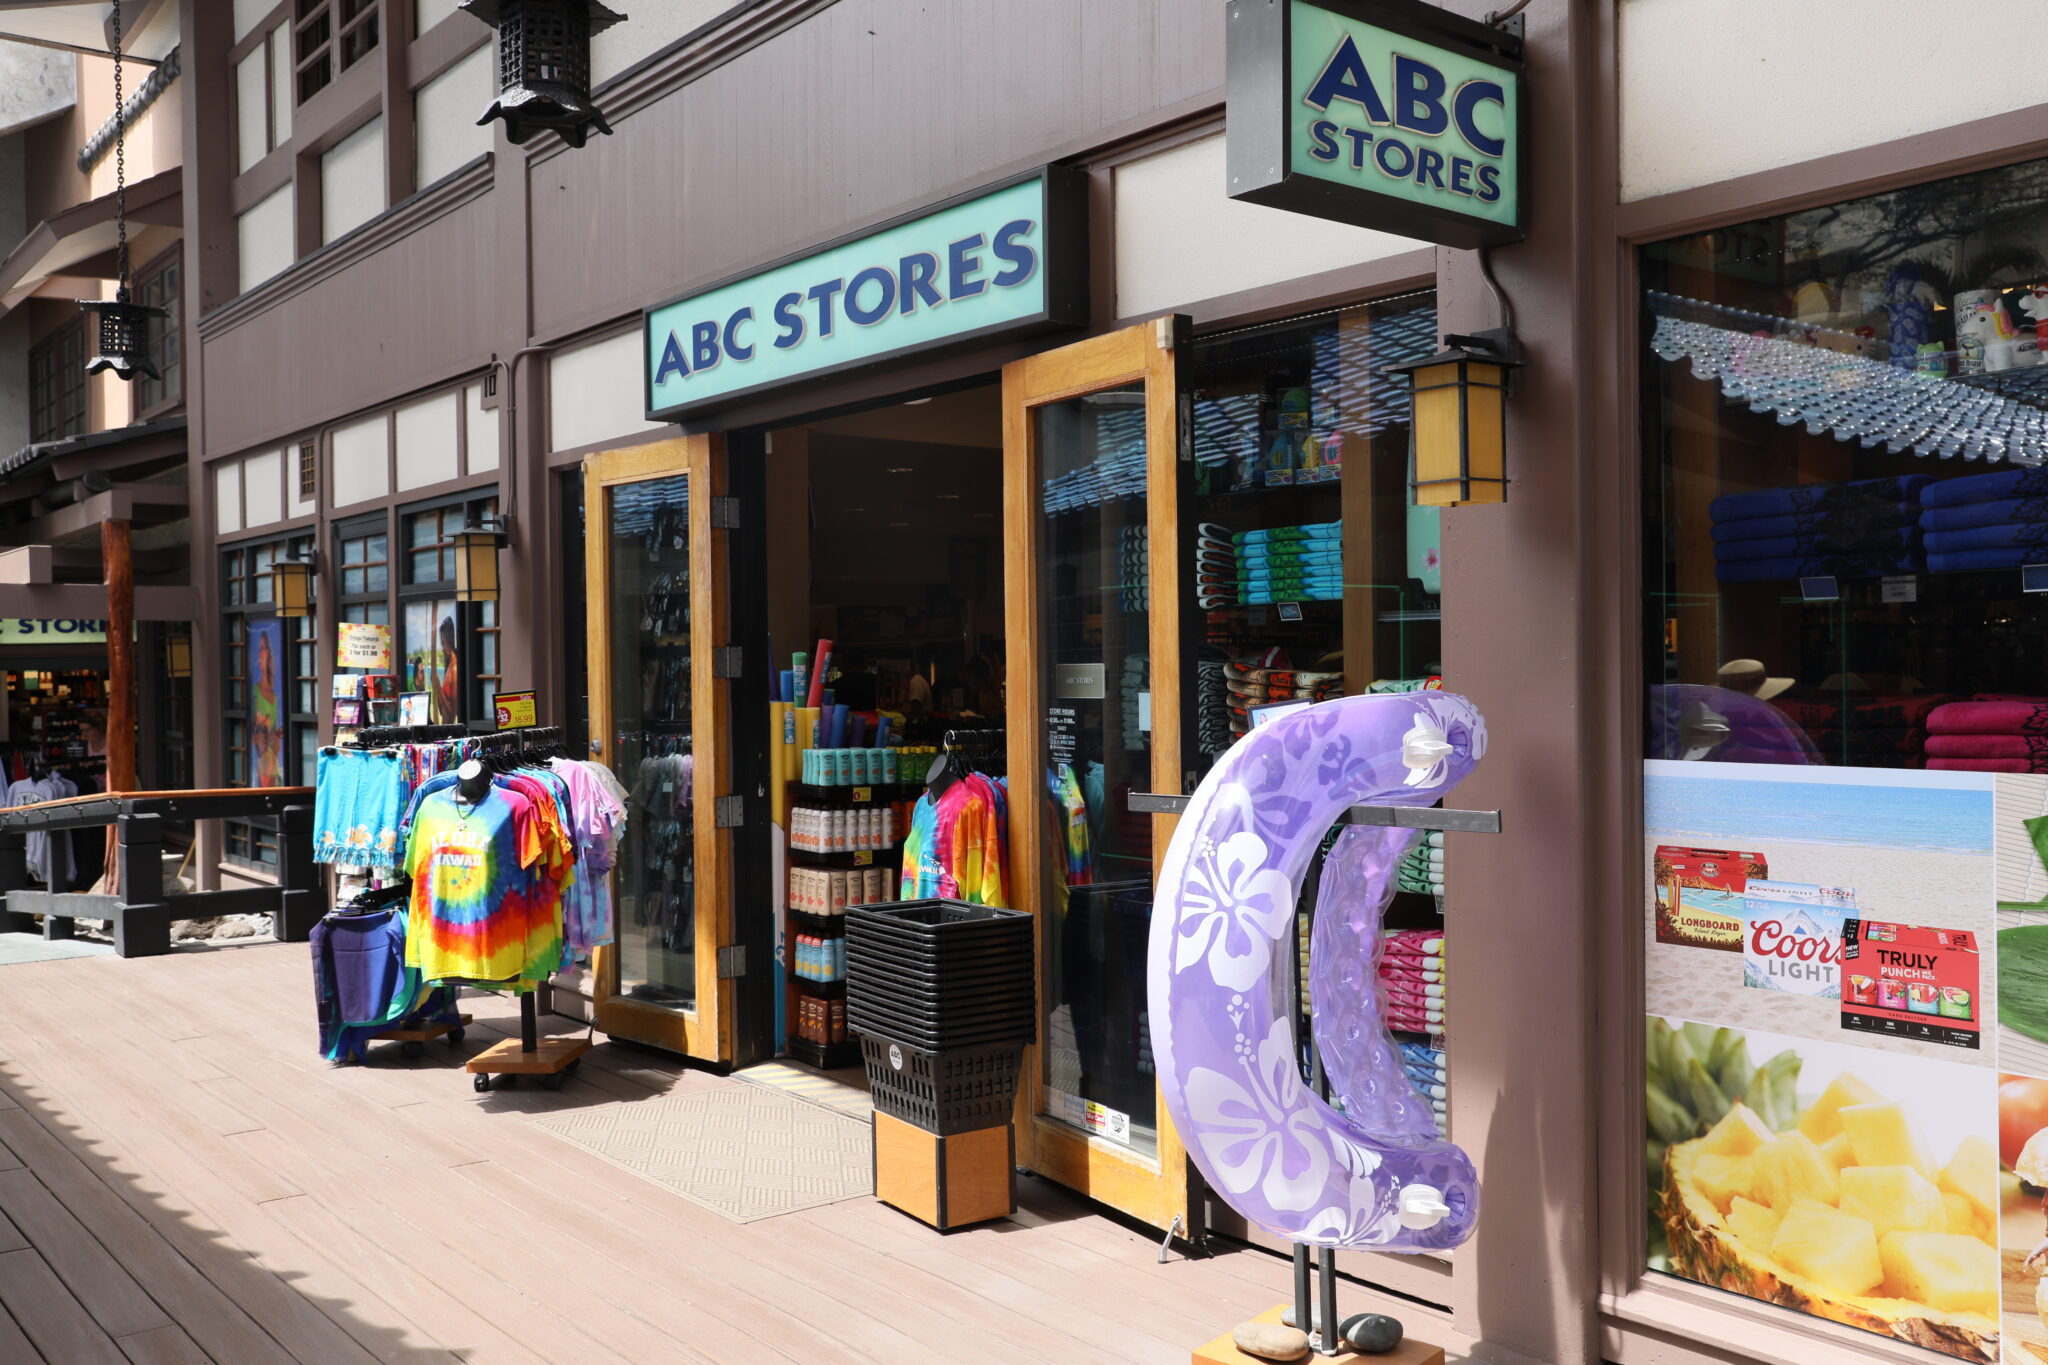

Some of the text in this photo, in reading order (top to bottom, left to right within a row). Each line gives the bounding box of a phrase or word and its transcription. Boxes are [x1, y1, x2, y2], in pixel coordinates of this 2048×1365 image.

[1303, 32, 1506, 158] ABC
[1309, 119, 1501, 202] STORES
[654, 219, 1037, 386] ABC STORES
[18, 619, 106, 634] STOR
[515, 715, 532, 724] 16.99
[432, 832, 491, 853] ALOHA
[434, 854, 483, 866] HAWAII
[1681, 917, 1740, 931] LONGBOARD
[1750, 920, 1842, 966] Coors
[1876, 949, 1938, 970] TRULY
[1768, 959, 1834, 983] LIGHT
[1881, 966, 1921, 979] PUNCH
